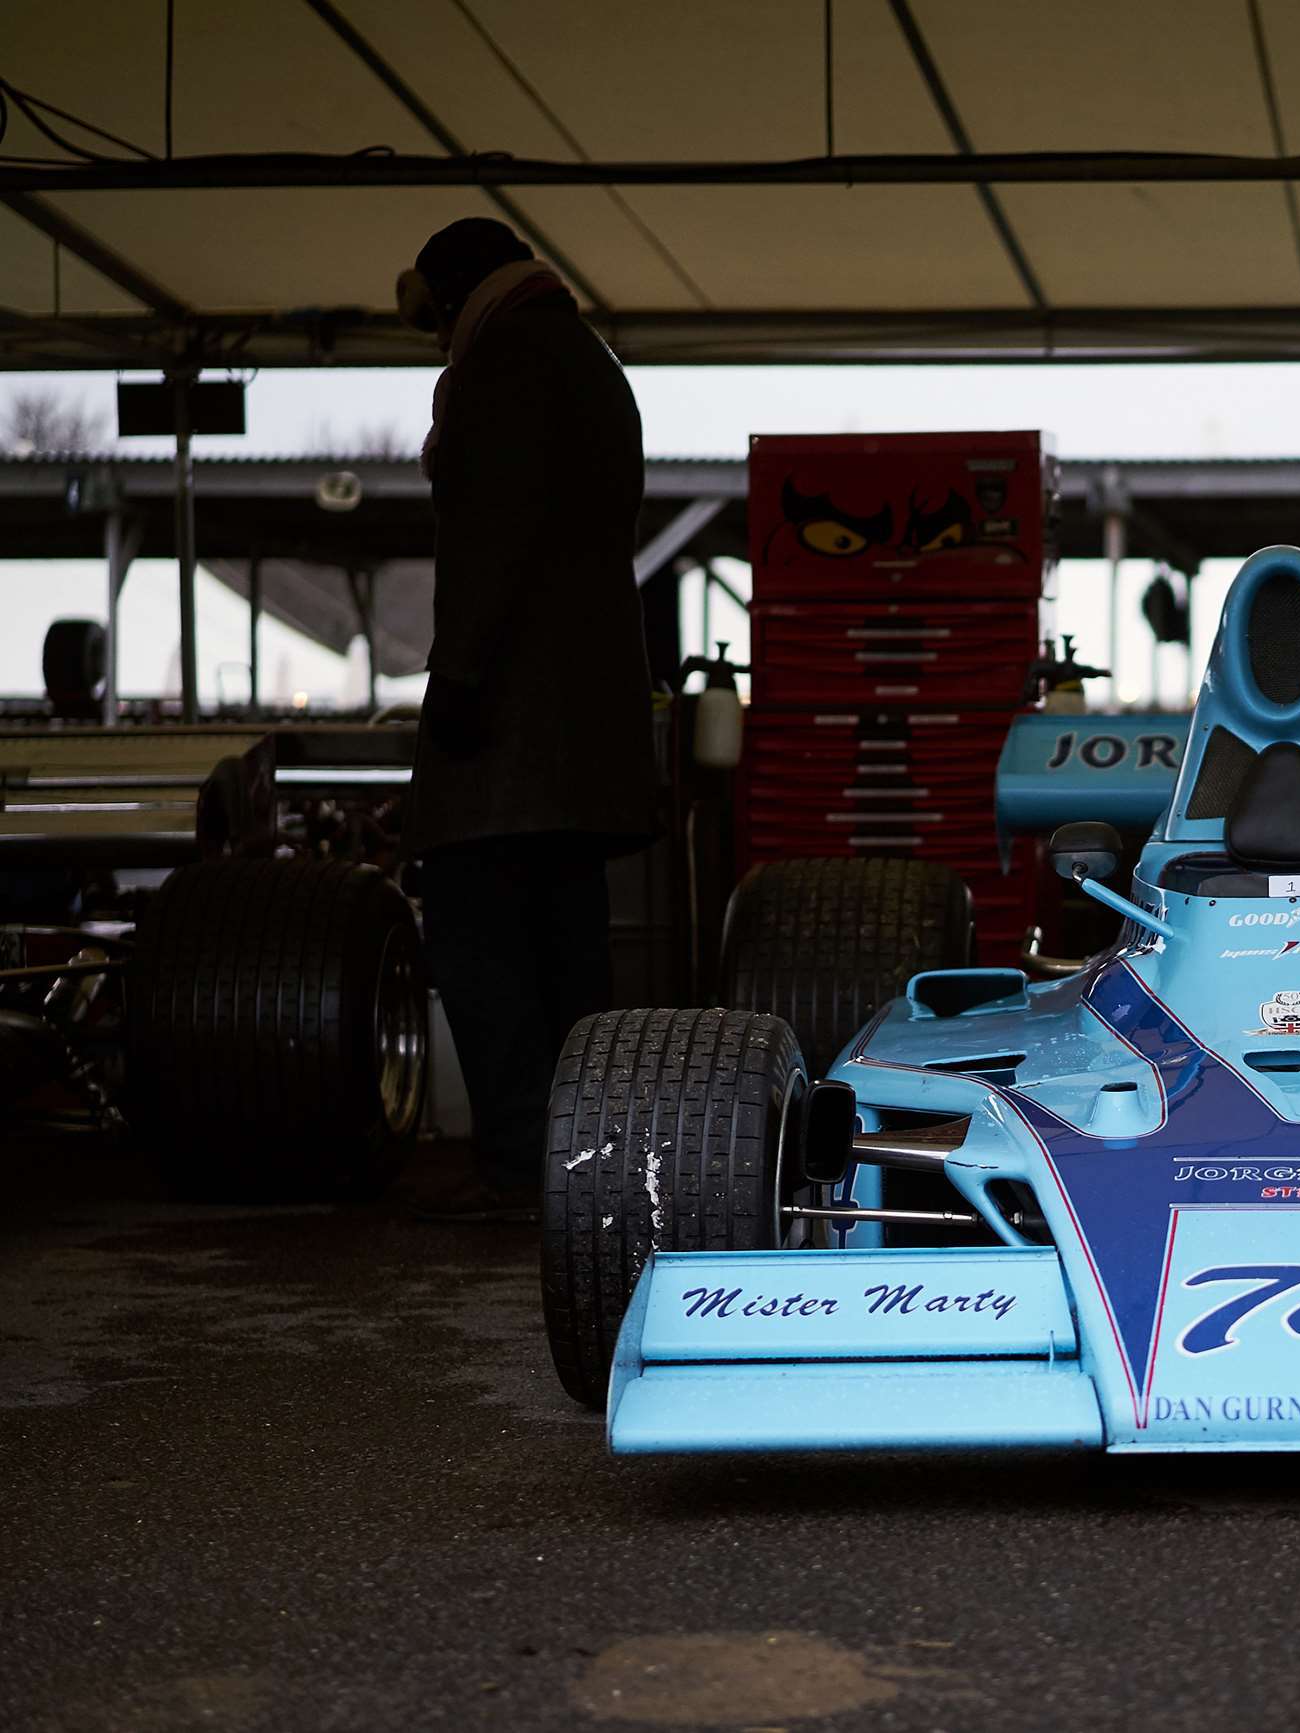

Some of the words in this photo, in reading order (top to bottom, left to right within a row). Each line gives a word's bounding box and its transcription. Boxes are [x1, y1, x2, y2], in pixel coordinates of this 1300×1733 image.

[1286, 881, 1297, 893] 1
[682, 1287, 840, 1318] Mister
[864, 1284, 1018, 1320] Marty
[1155, 1396, 1212, 1421] DAN
